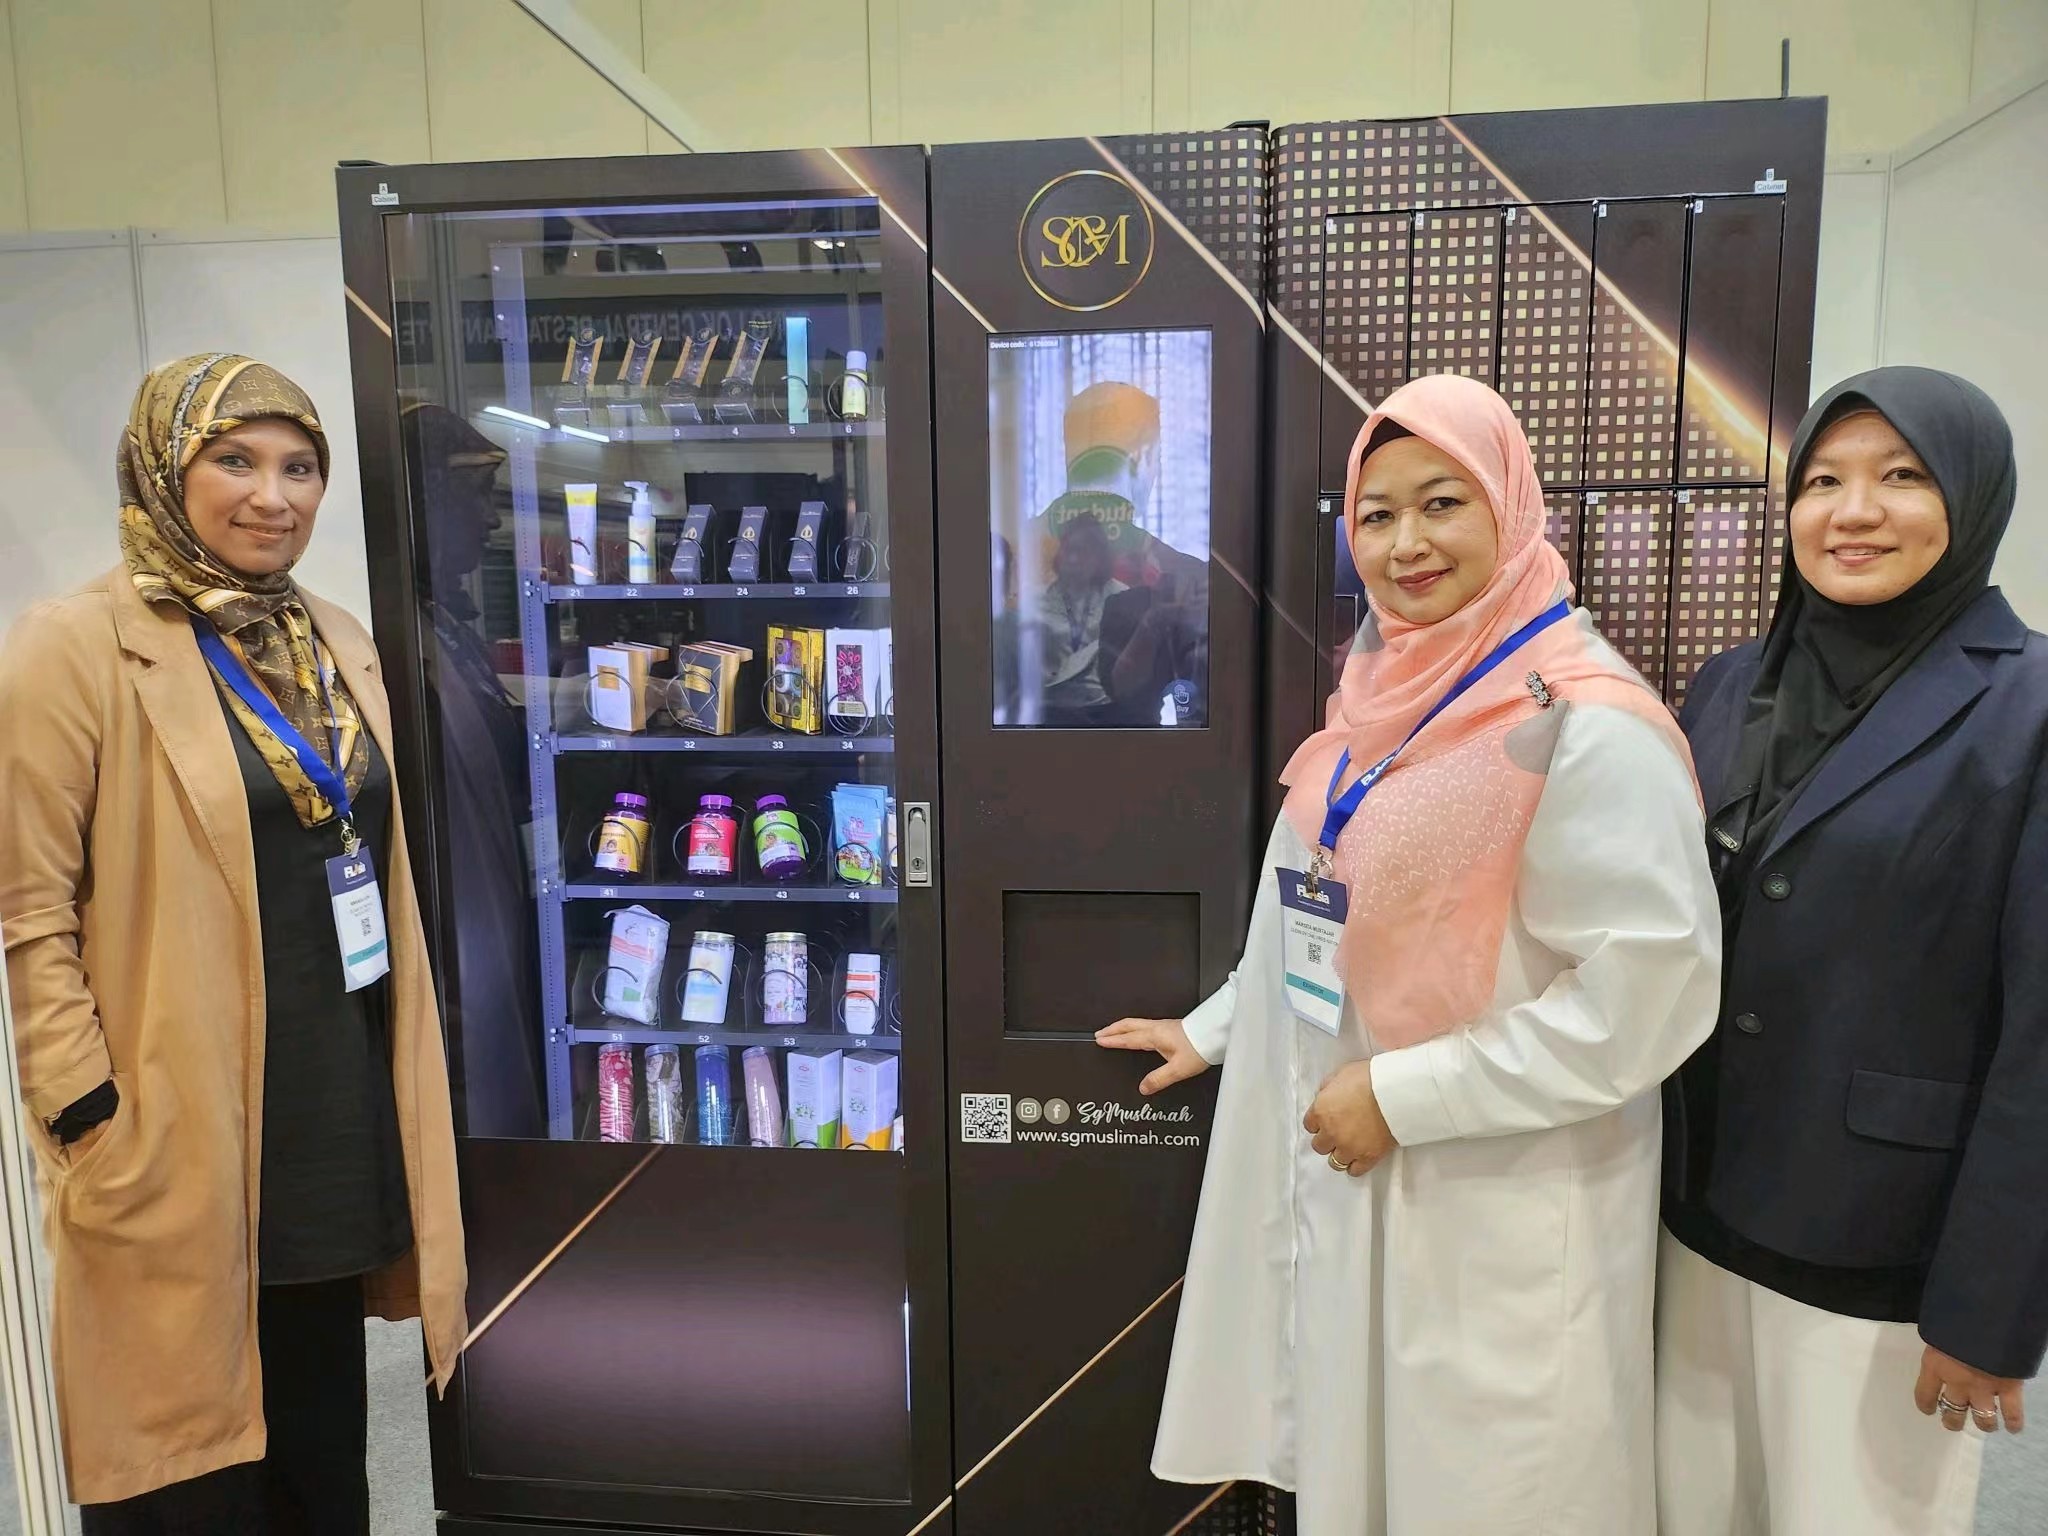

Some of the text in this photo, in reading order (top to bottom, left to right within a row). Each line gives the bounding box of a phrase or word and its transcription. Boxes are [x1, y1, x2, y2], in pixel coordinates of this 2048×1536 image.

[1756, 183, 1785, 192] Cabinet
[618, 430, 624, 438] 2
[674, 428, 680, 437] 3
[732, 427, 739, 436] 4
[789, 426, 795, 434] 5
[845, 425, 852, 434] 6
[570, 588, 581, 597] 21
[626, 587, 638, 597] 22
[683, 587, 695, 596] 23
[736, 587, 749, 596] 24
[794, 586, 806, 596] 25
[846, 586, 859, 595] 26
[601, 740, 612, 749] 31
[684, 740, 696, 749] 32
[772, 740, 784, 749] 33
[842, 741, 854, 750] 34
[603, 889, 614, 898] 41
[693, 890, 705, 898] 42
[775, 891, 788, 899] 43
[848, 891, 860, 900] 44
[612, 1033, 623, 1041] 51
[698, 1035, 710, 1043] 52
[784, 1037, 796, 1046] 53
[855, 1038, 867, 1048] 54
[1016, 1129, 1200, 1147] www.sgmuslimah.com
